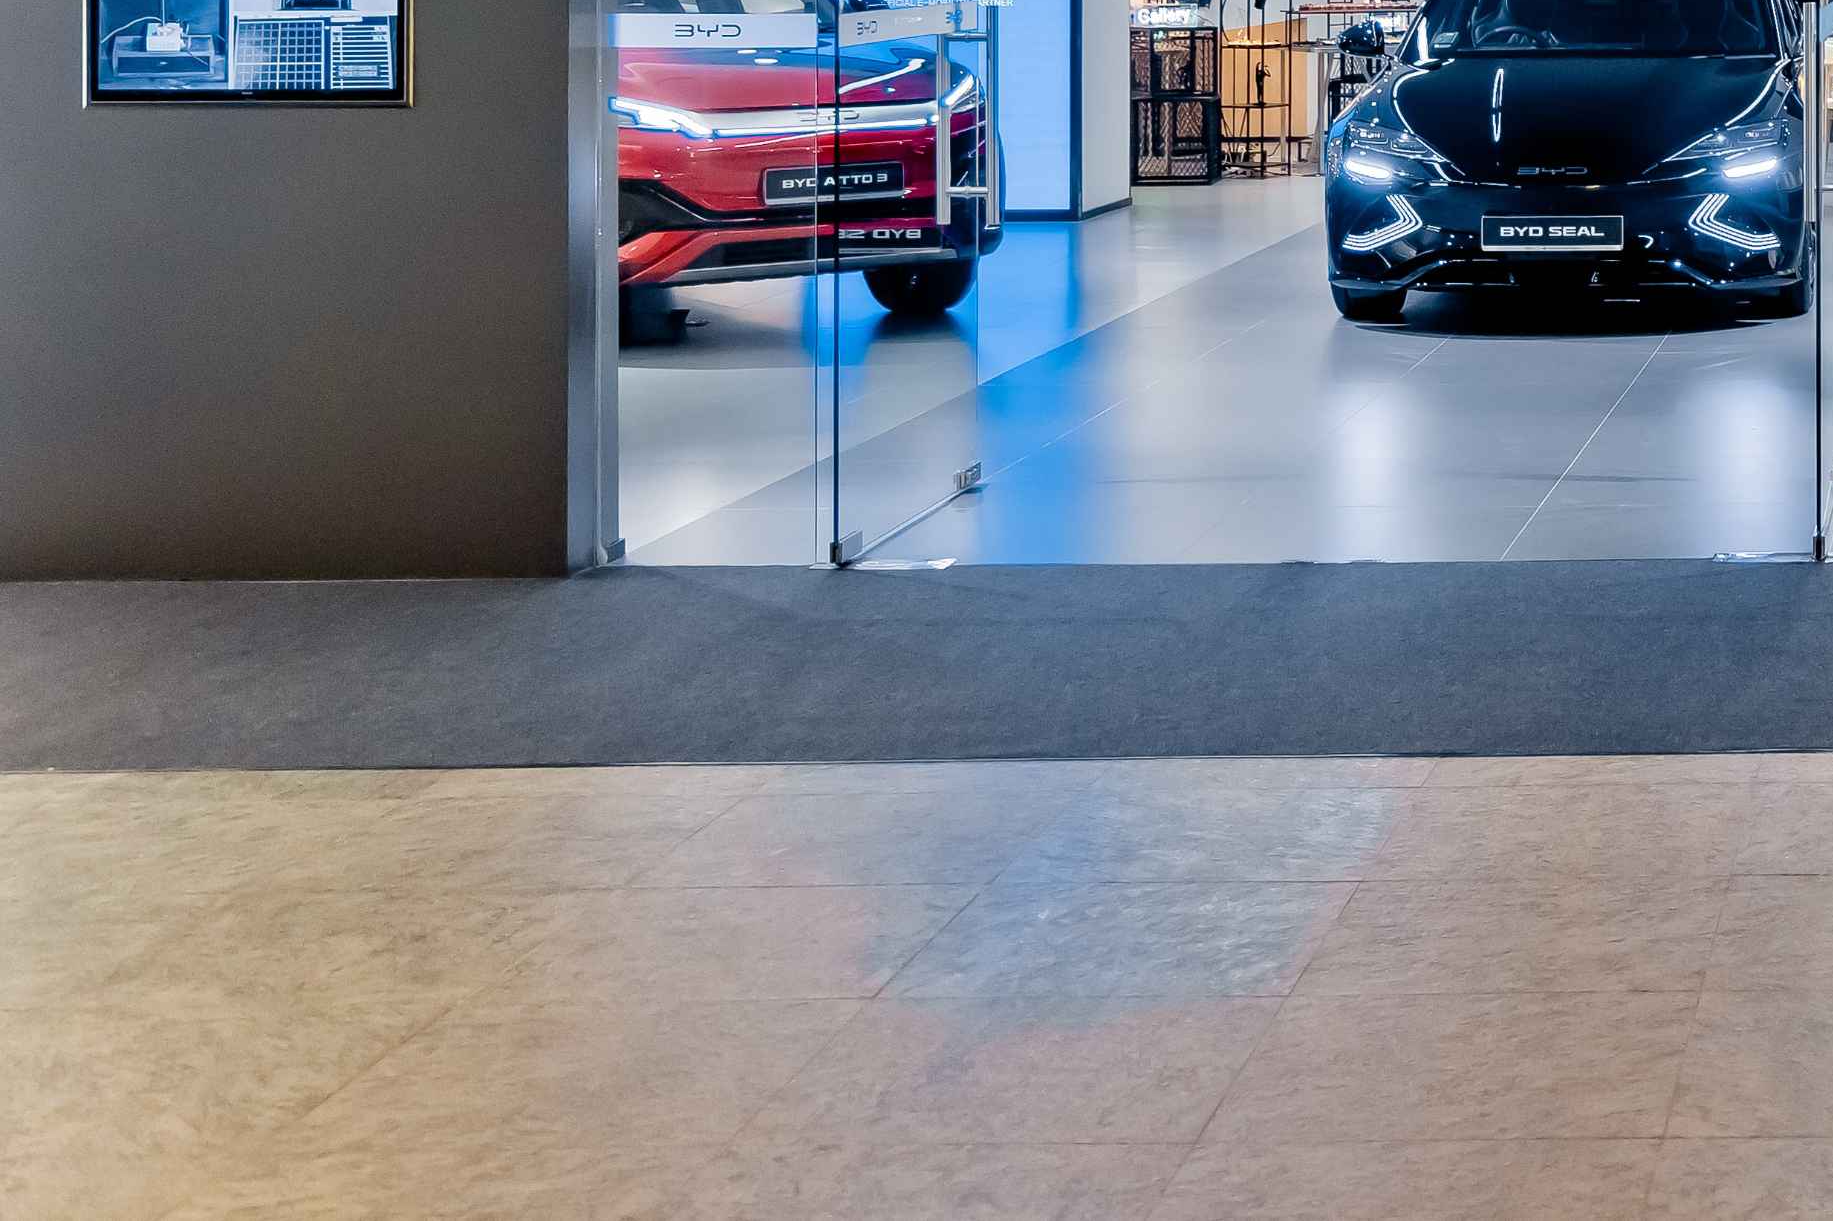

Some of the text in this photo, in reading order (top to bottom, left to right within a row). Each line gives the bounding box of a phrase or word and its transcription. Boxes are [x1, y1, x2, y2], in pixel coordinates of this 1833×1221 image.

[674, 23, 742, 38] BYD
[1516, 166, 1589, 176] BYD
[823, 174, 874, 187] ATTO
[877, 173, 889, 183] 3
[1499, 226, 1606, 237] BYD SEAL
